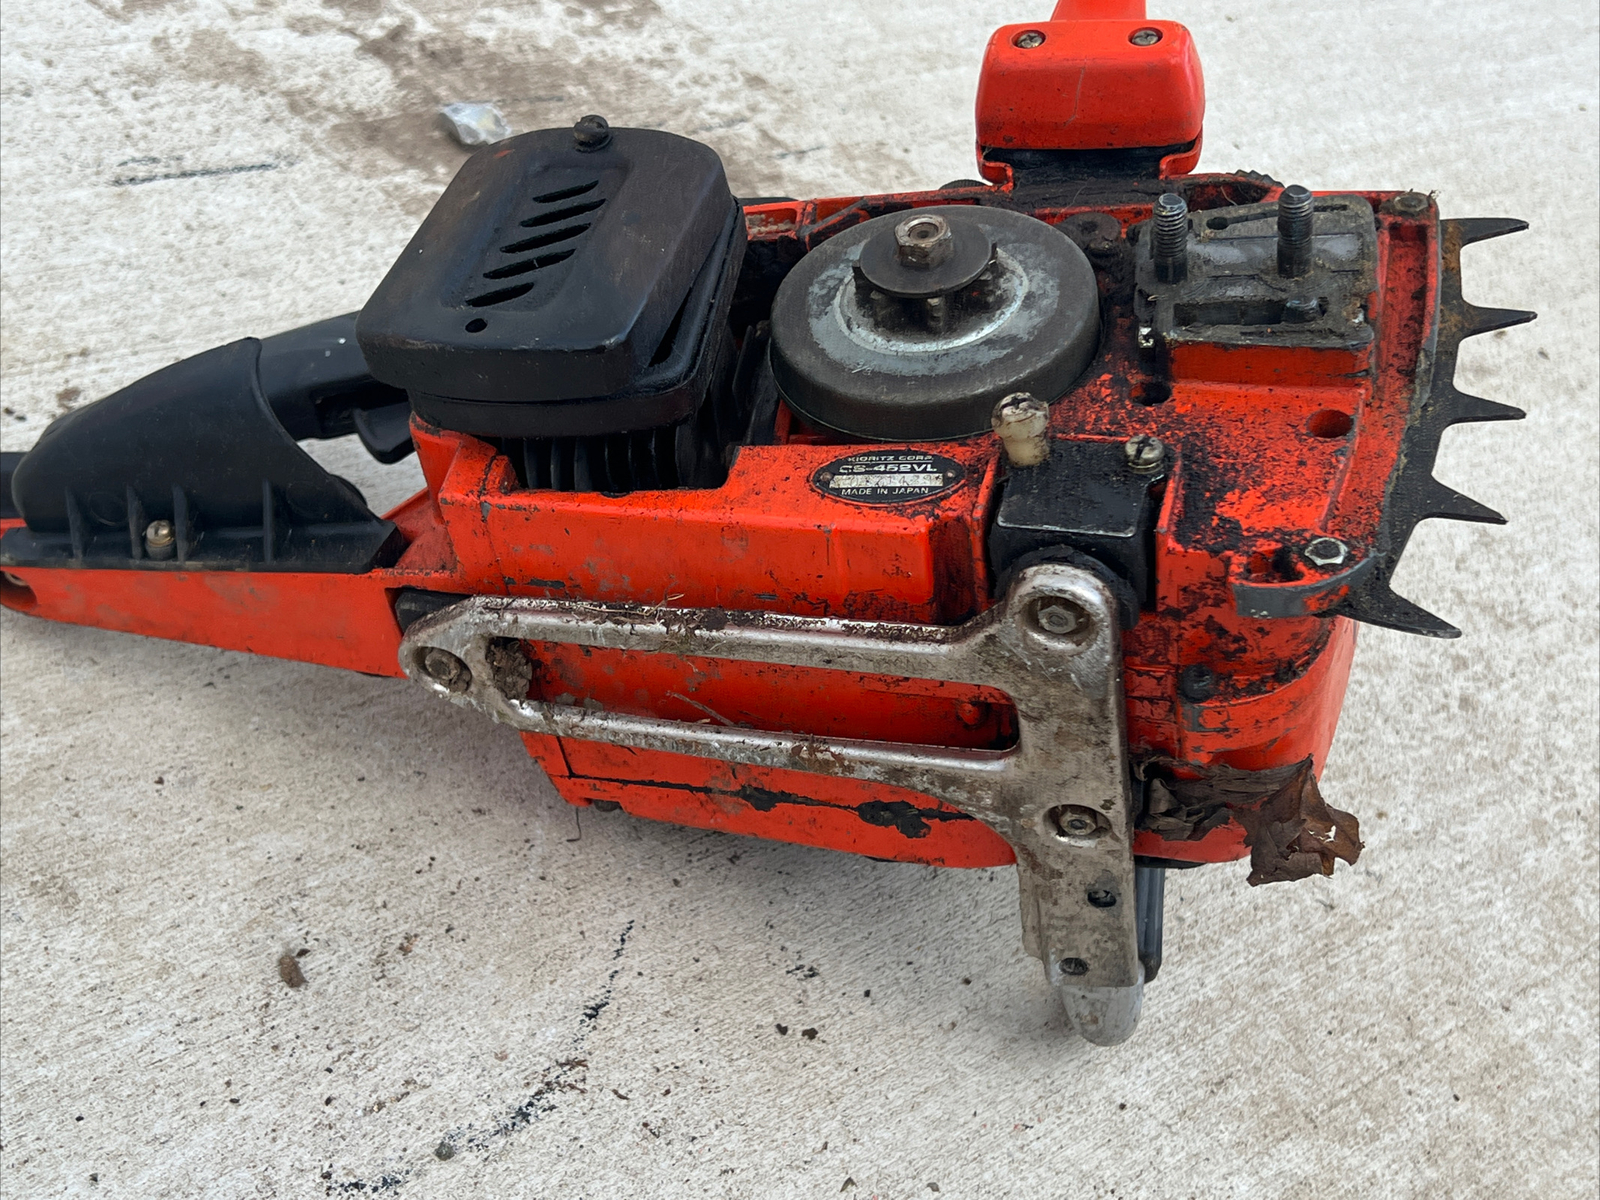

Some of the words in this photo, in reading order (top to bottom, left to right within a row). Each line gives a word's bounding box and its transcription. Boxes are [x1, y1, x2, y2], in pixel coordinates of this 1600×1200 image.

[839, 463, 938, 473] CS-452VL
[841, 487, 872, 496] MADE
[877, 487, 889, 495] IN
[892, 487, 929, 495] JAPAN
